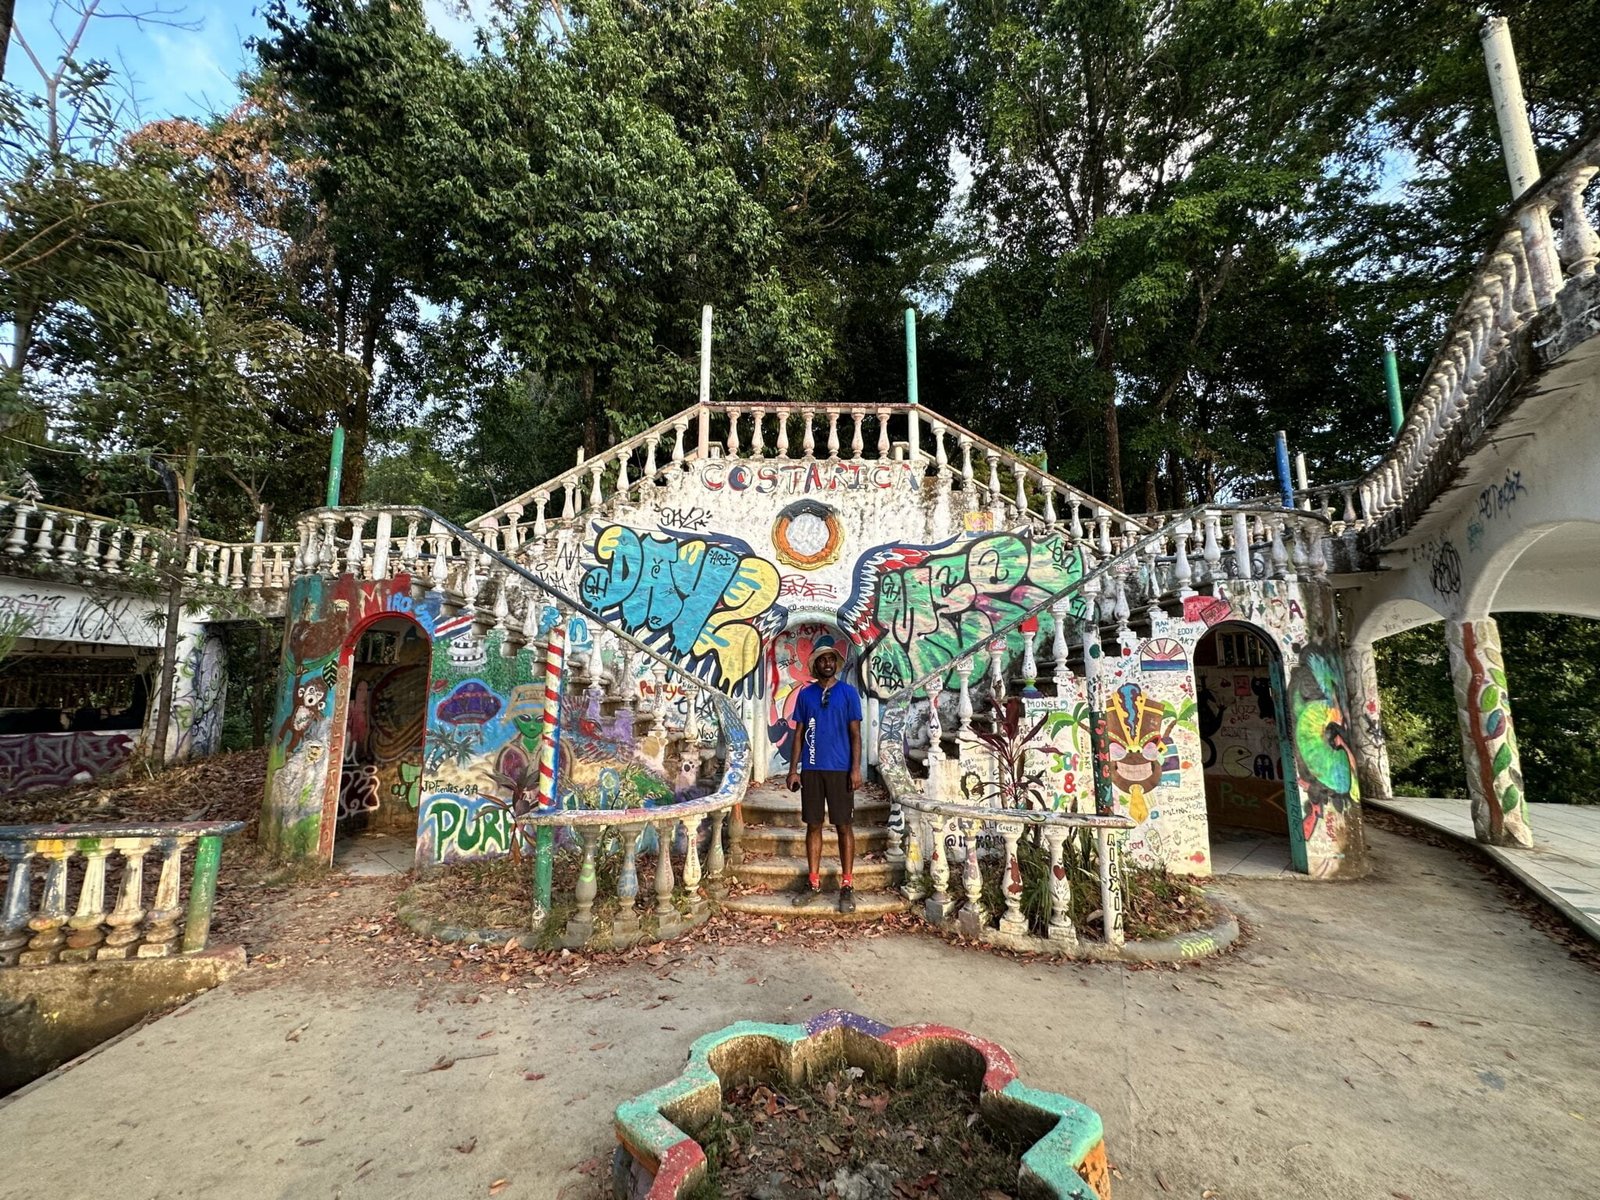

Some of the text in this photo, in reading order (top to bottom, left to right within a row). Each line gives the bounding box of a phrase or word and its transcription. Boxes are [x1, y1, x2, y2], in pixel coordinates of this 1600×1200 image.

[701, 463, 919, 494] COSTA RICA
[871, 656, 900, 676] PURA
[870, 669, 904, 689] VIDA
[1028, 700, 1058, 708] MONSE
